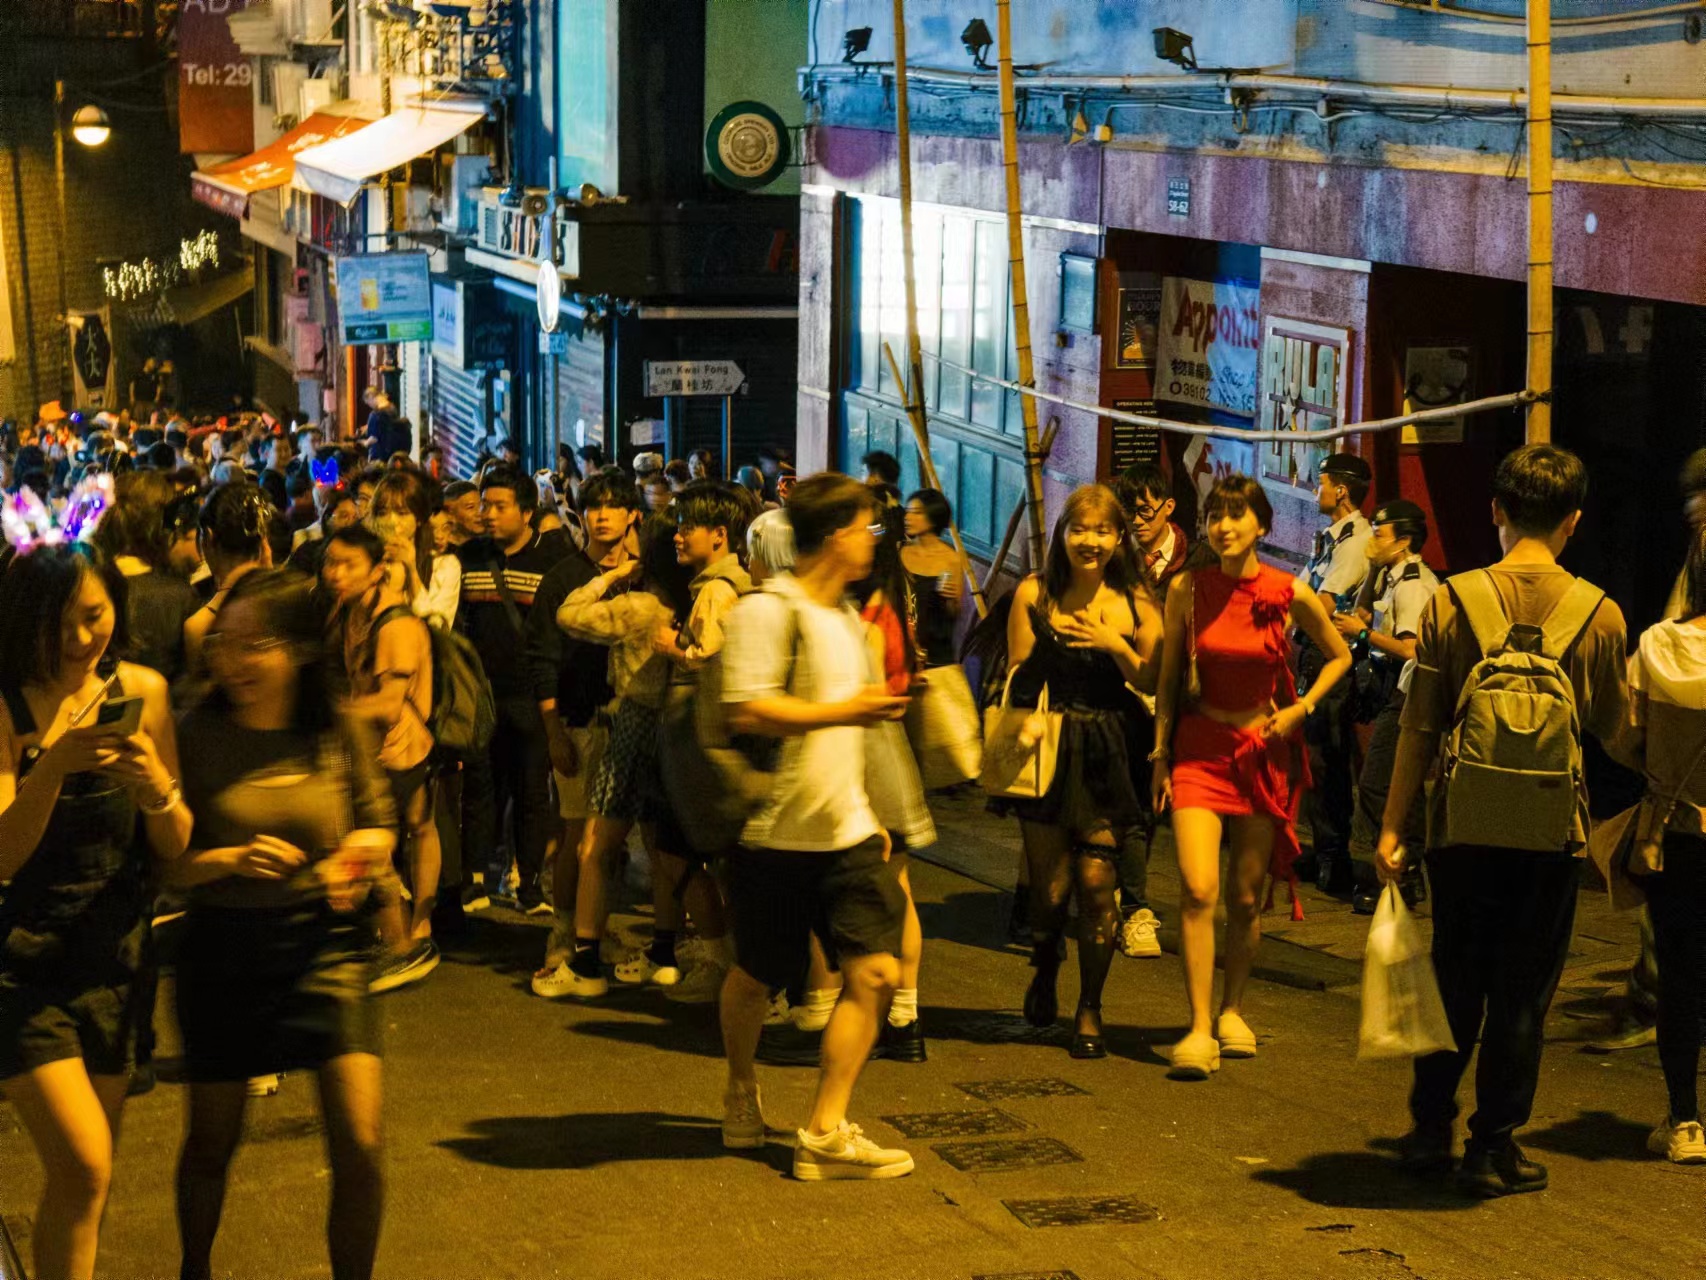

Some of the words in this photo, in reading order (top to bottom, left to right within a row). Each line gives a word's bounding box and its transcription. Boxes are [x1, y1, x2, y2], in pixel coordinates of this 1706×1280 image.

[655, 366, 673, 375] Lan
[677, 365, 700, 375] Kwai
[705, 364, 729, 376] Fong
[1266, 335, 1334, 409] RULA
